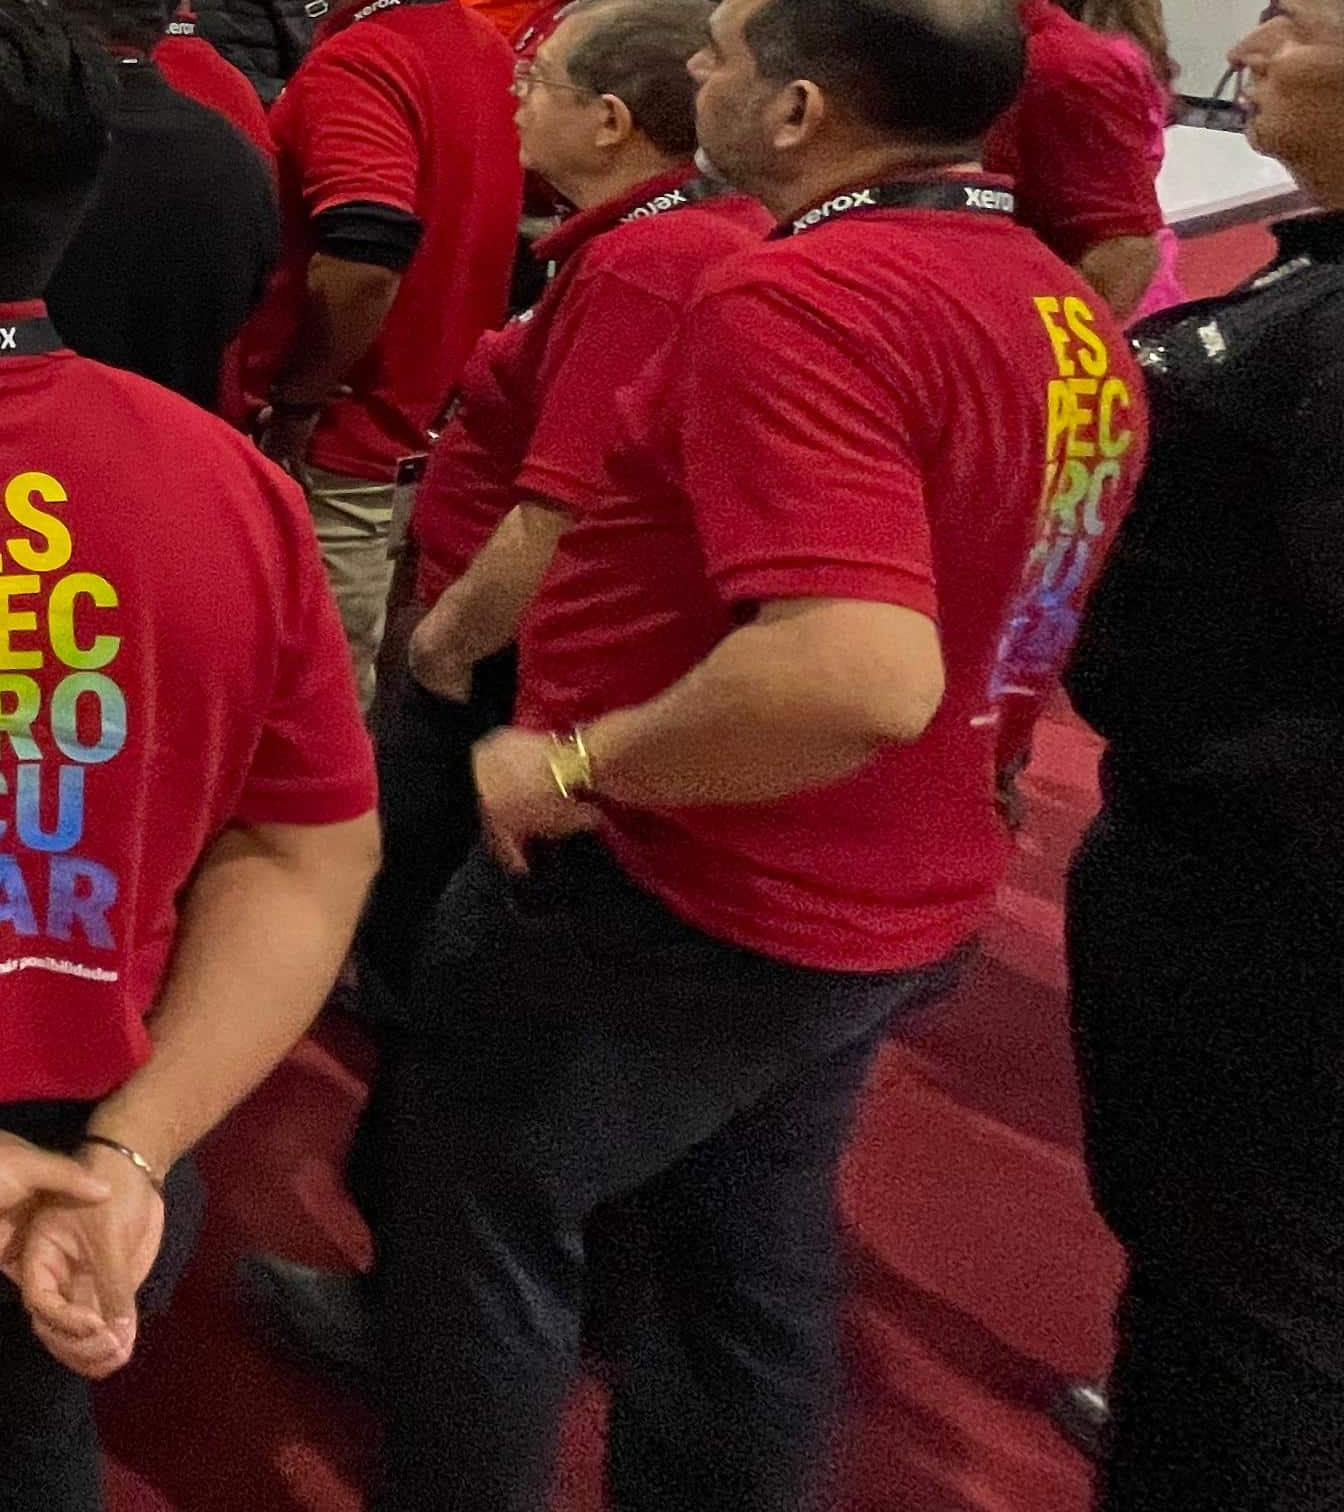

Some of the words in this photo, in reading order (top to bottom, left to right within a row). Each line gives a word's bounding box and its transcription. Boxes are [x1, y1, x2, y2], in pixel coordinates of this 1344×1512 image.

[793, 189, 876, 235] xerox
[964, 187, 1014, 212] xero
[1034, 296, 1108, 377] ES
[1047, 377, 1131, 462] PEC
